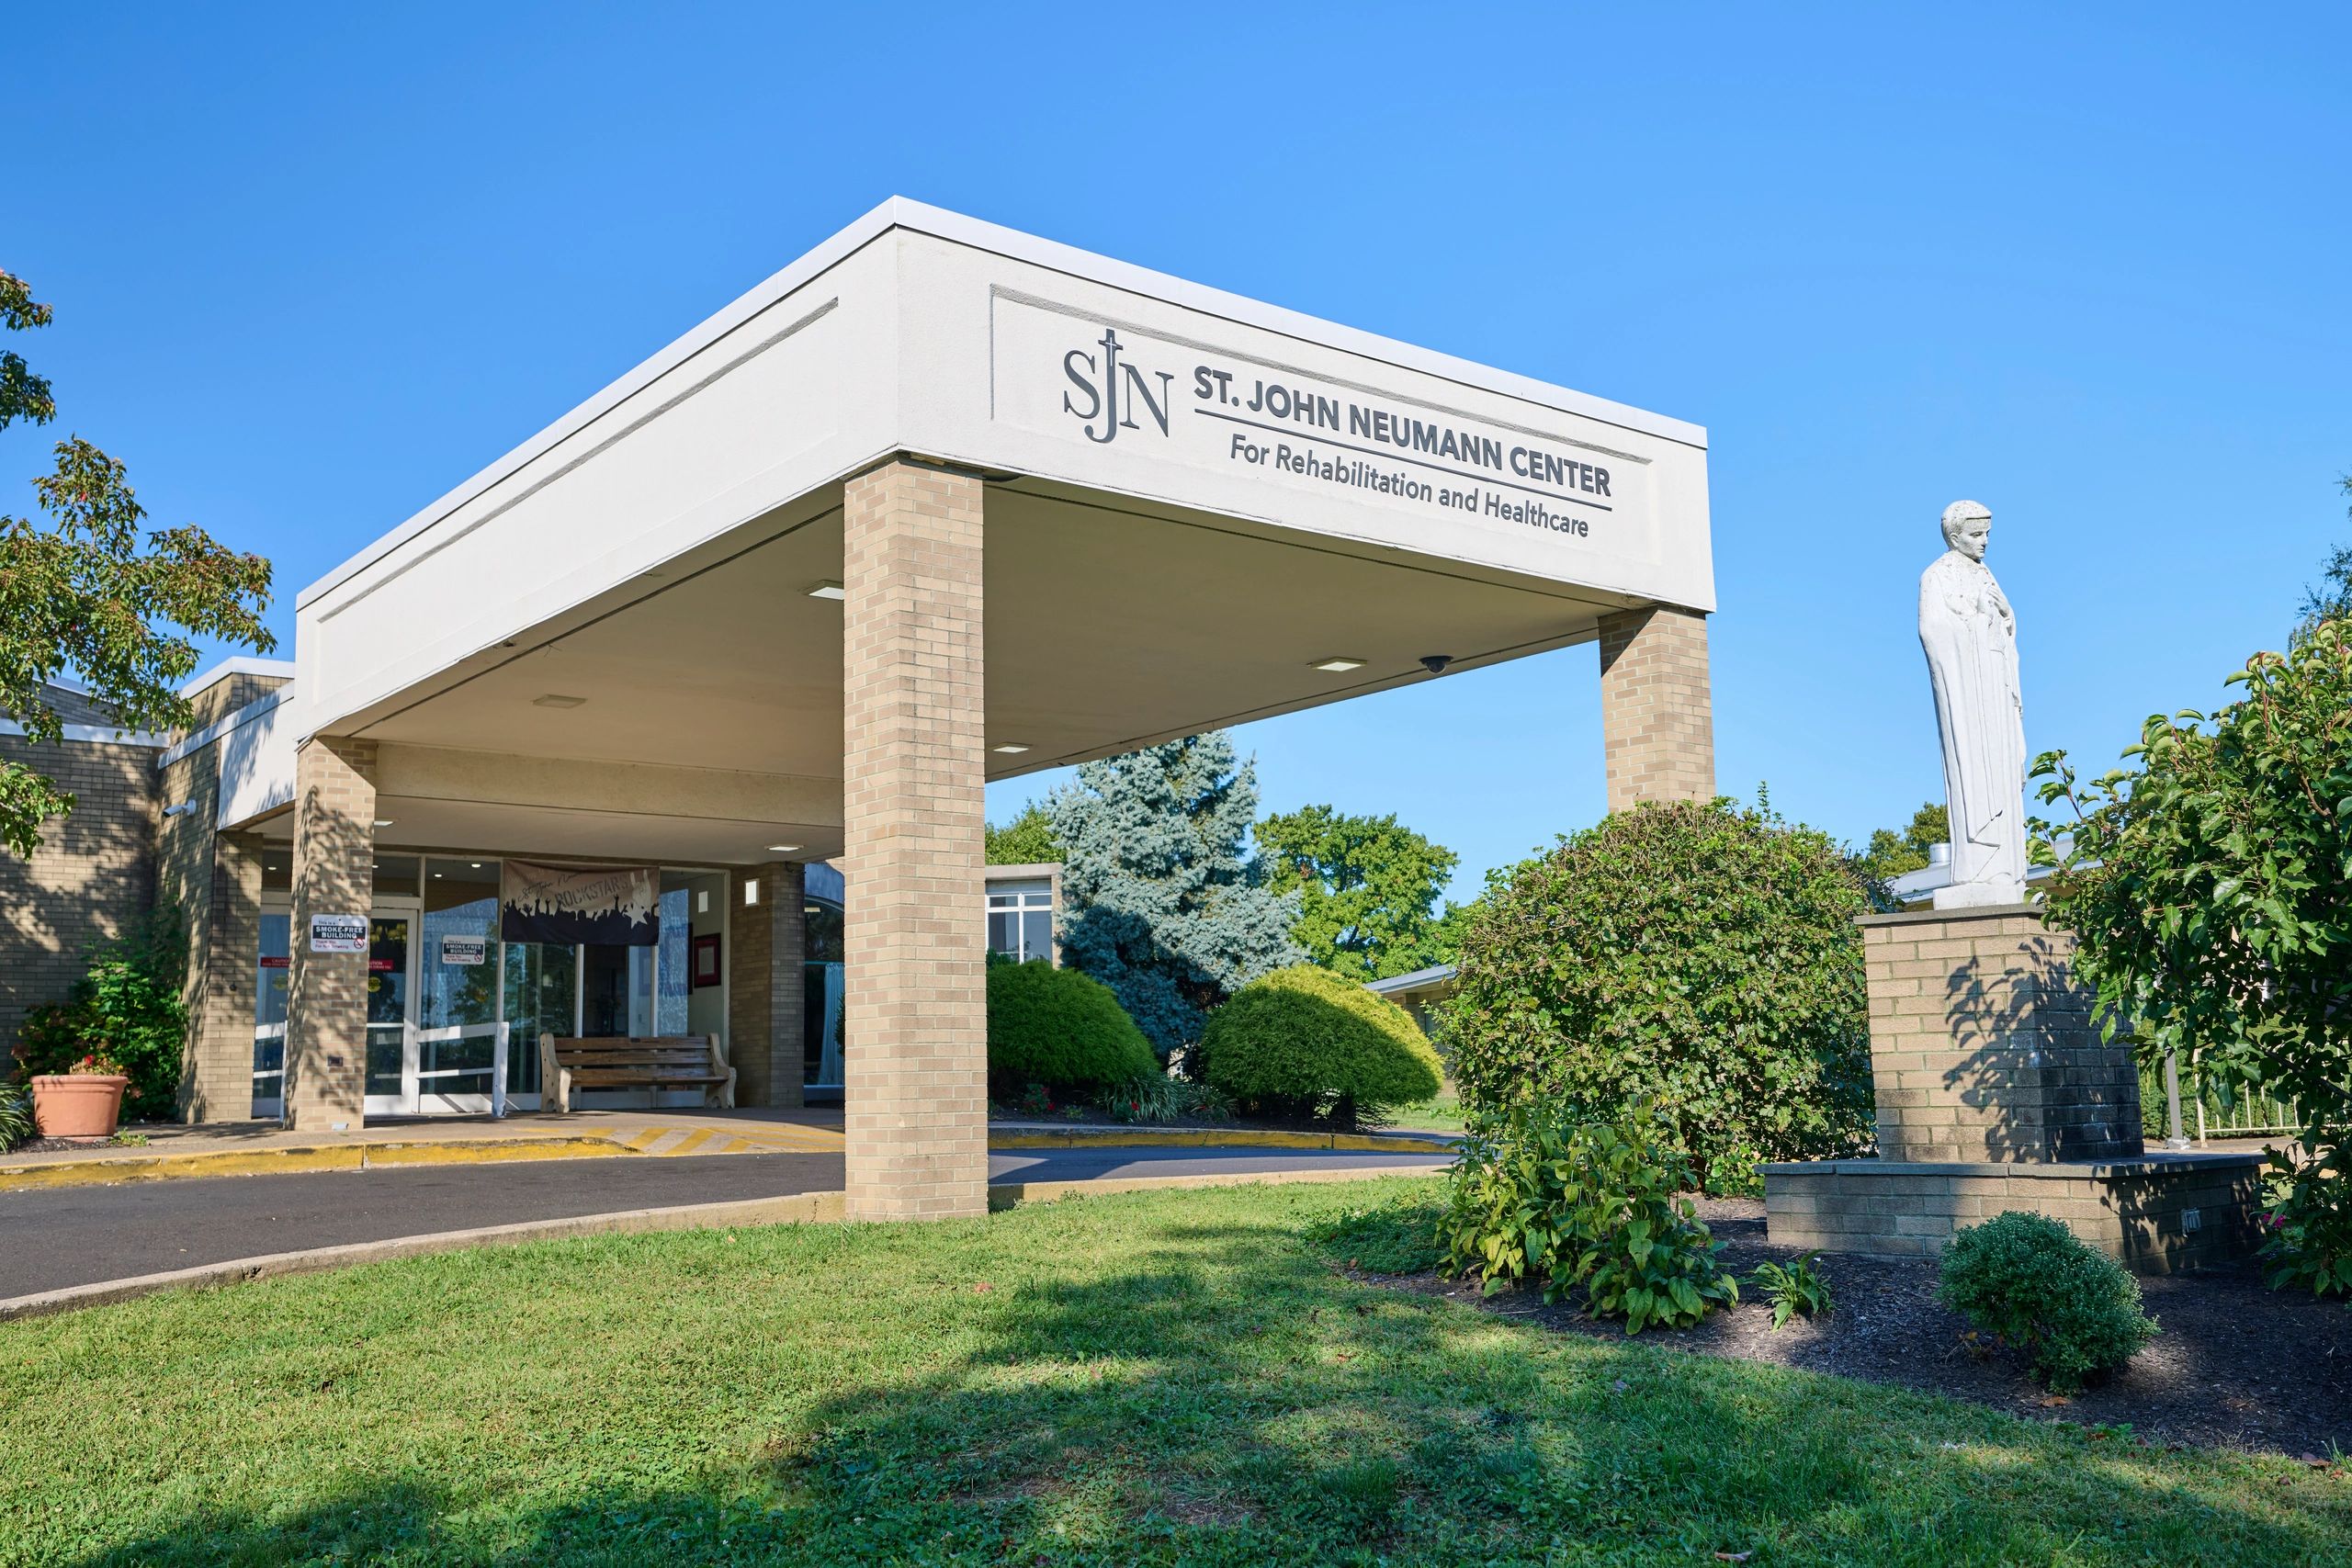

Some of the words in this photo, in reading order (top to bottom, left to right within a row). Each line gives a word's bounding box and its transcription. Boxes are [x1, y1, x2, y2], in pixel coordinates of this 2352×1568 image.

[1064, 329, 1174, 444] SJN
[1193, 365, 1239, 407] ST.
[1246, 379, 1340, 432] JOHN
[1349, 403, 1502, 471] NEUMANN
[1510, 445, 1611, 498] CENTER
[1231, 433, 1271, 466] For
[1275, 443, 1432, 503] Rehabilitation
[1438, 487, 1479, 514] and
[1484, 491, 1589, 538] Healthcare
[315, 926, 364, 934] SMOKE-FREE
[555, 873, 629, 908] ROCKSTARS
